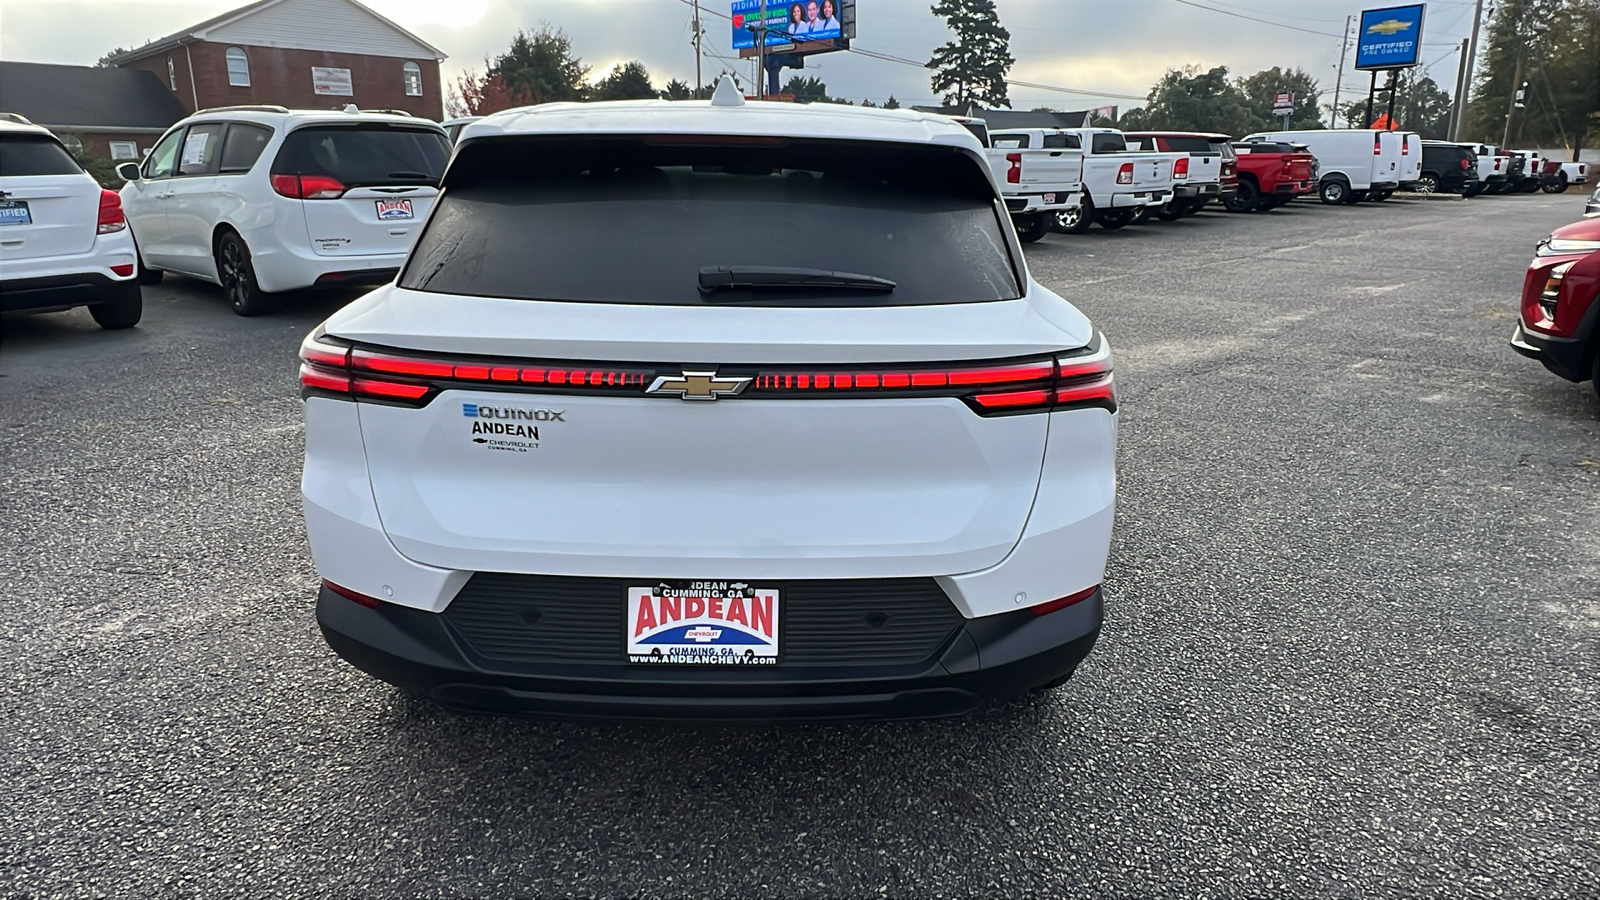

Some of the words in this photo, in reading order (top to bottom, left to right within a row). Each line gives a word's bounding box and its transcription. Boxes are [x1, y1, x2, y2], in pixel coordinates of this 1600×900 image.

[733, 0, 770, 11] PEDIATRC
[772, 9, 787, 17] KIDS
[1362, 41, 1413, 51] CERTIFIED
[463, 404, 566, 422] EQUINOX
[472, 421, 540, 440] ANDEAN
[489, 440, 540, 449] CHEVROLET
[688, 581, 728, 590] NDEAN
[662, 589, 724, 598] CUMMING,
[727, 590, 744, 598] GA
[635, 595, 773, 638] ANDEAN
[669, 647, 719, 656] CUMMING,
[630, 655, 776, 665] www.ANDEANCHEVY.com
